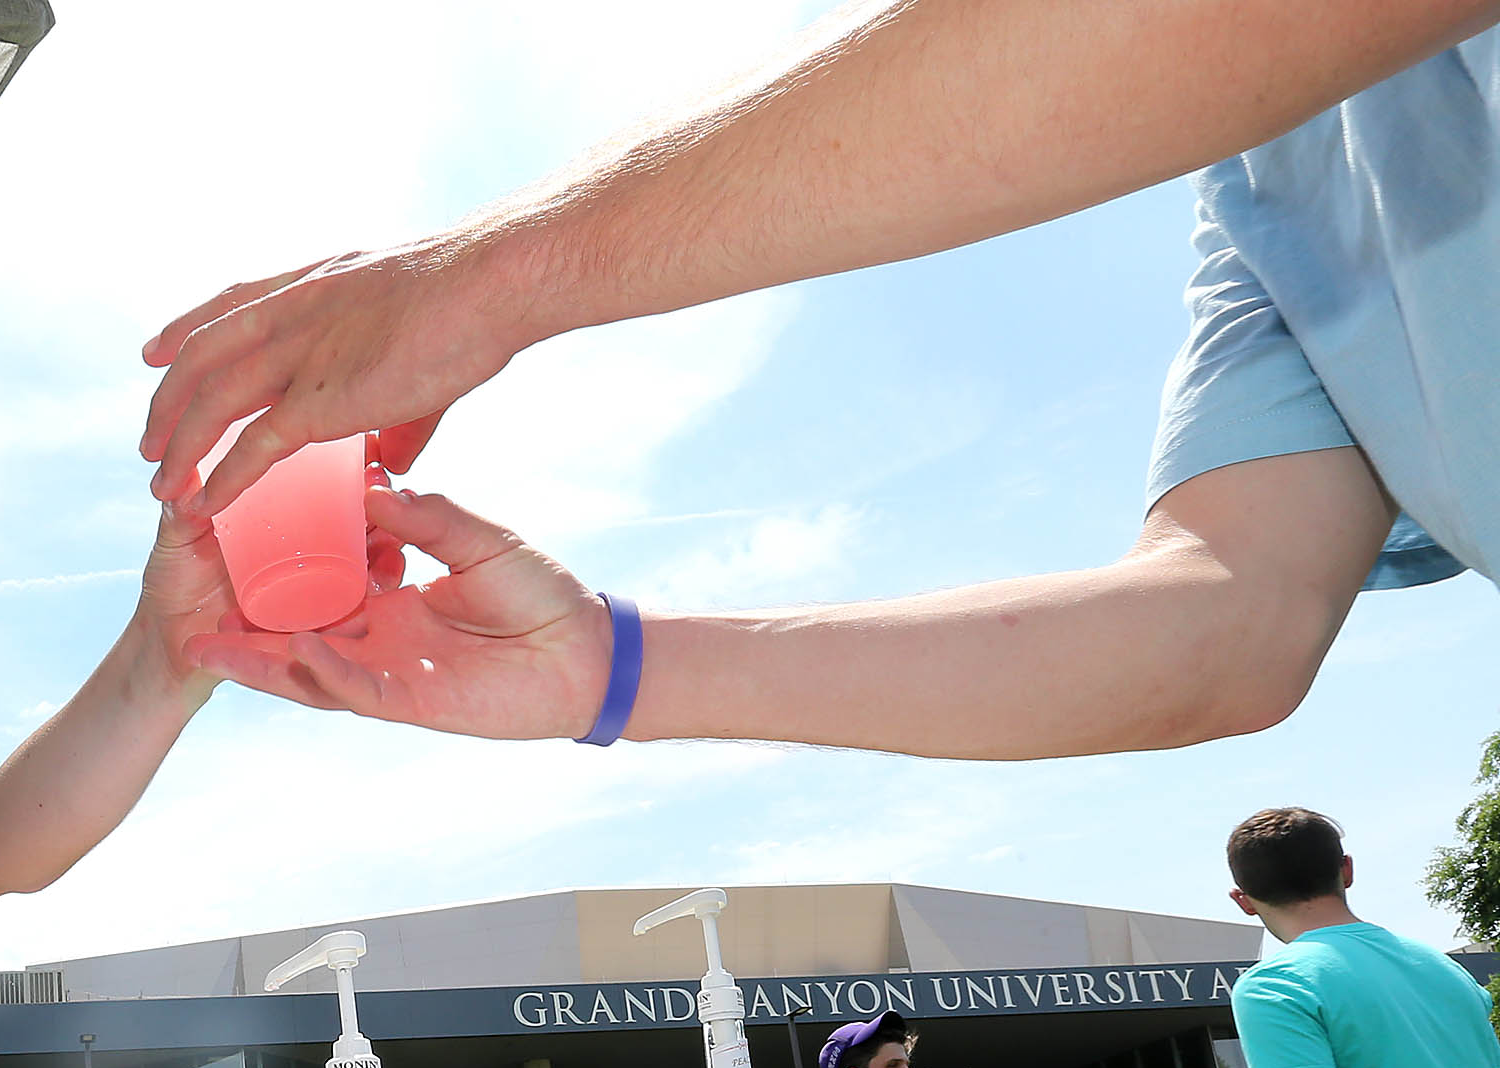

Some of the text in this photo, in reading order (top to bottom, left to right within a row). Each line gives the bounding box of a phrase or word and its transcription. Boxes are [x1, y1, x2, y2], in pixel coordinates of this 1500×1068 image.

[513, 987, 696, 1027] GRAND
[747, 979, 916, 1018] ANYON
[930, 968, 1194, 1011] UNIVERSITY
